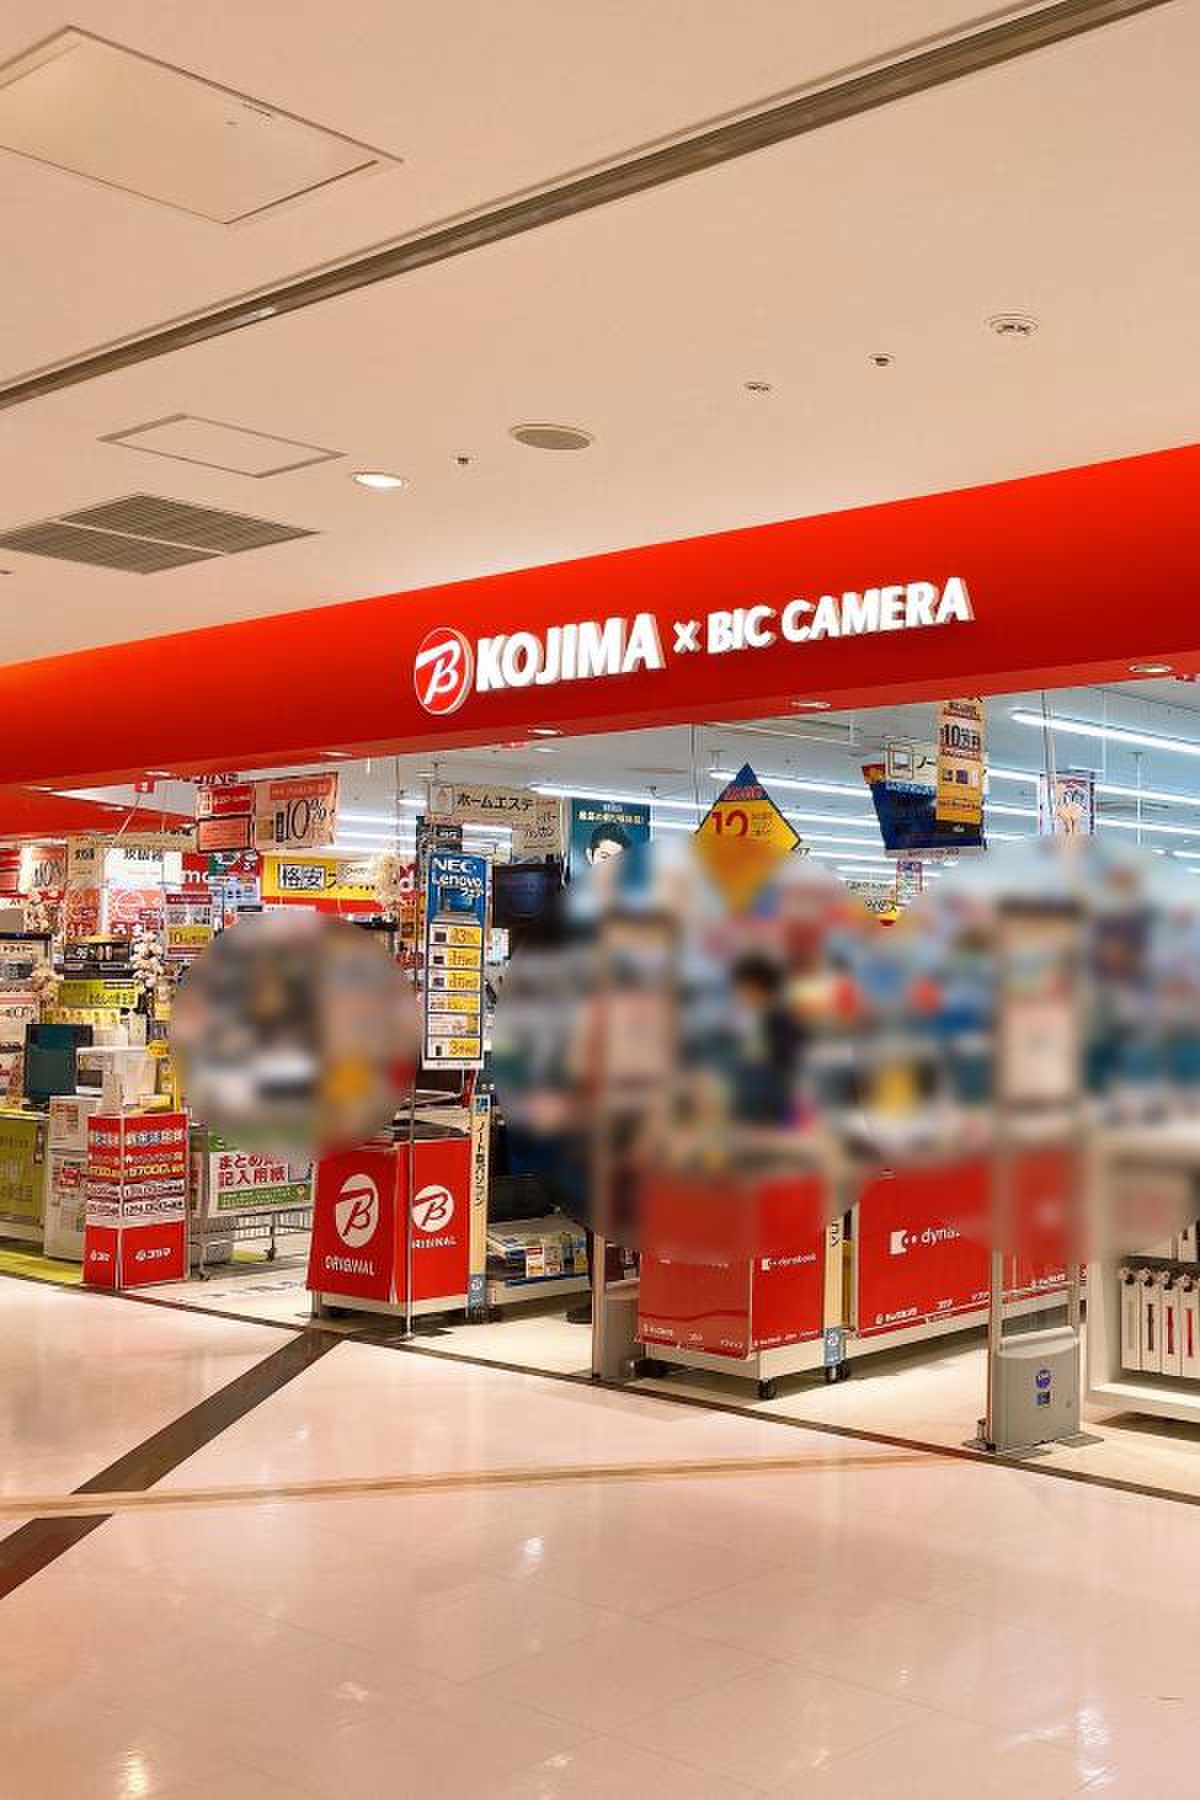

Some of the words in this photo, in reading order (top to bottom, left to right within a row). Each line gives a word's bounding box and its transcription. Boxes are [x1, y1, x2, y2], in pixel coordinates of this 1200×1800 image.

[475, 613, 664, 693] KOJIMA
[707, 607, 777, 655] BIC
[781, 577, 974, 643] CAMERA
[457, 792, 534, 811] ホームエステ
[431, 857, 475, 873] NEC
[431, 872, 484, 888] Lenovo
[217, 1166, 286, 1188] 記入用紙
[412, 1235, 458, 1249] RIGINAL
[324, 1254, 377, 1277] ORIGINAL
